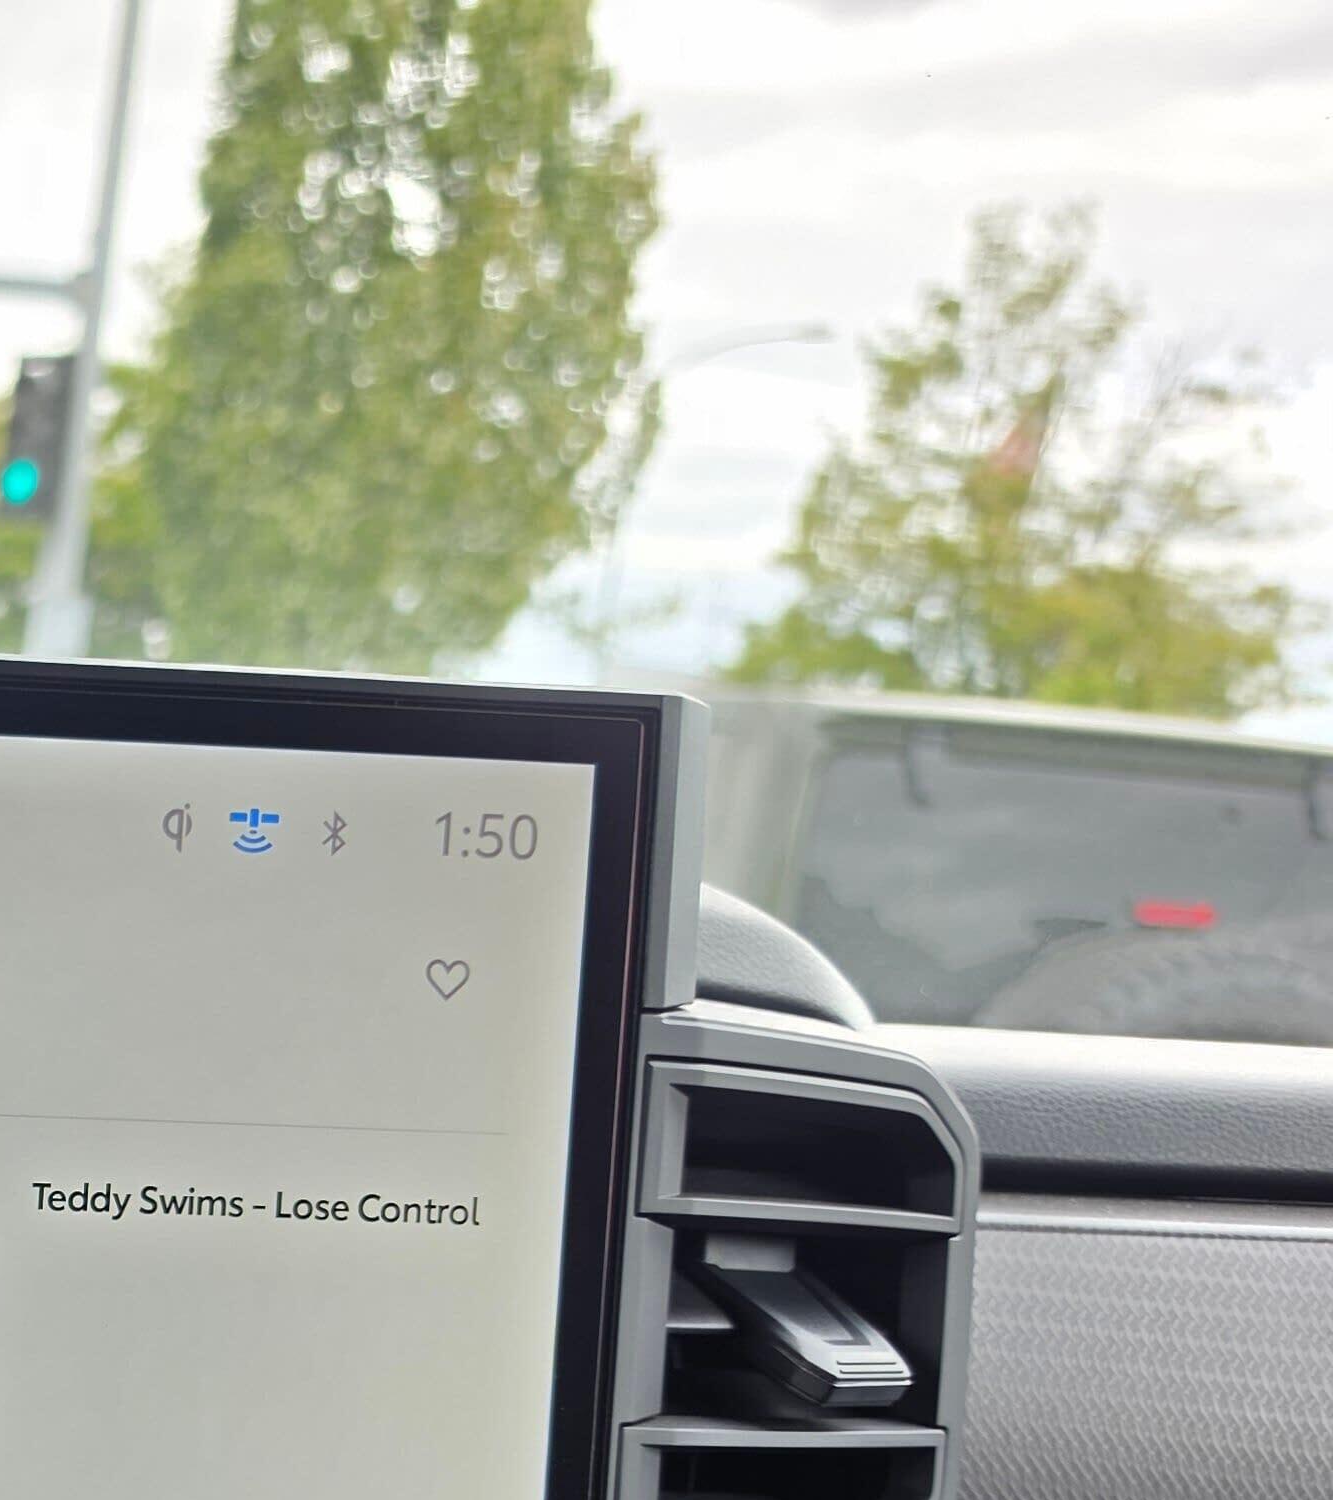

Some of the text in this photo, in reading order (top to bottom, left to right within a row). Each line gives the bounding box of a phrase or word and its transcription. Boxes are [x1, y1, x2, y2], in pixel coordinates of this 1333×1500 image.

[435, 811, 539, 861] 1:50
[33, 1182, 131, 1220] Teddy
[139, 1186, 244, 1217] Swims
[275, 1192, 349, 1221] Lose
[358, 1193, 480, 1226] Control
